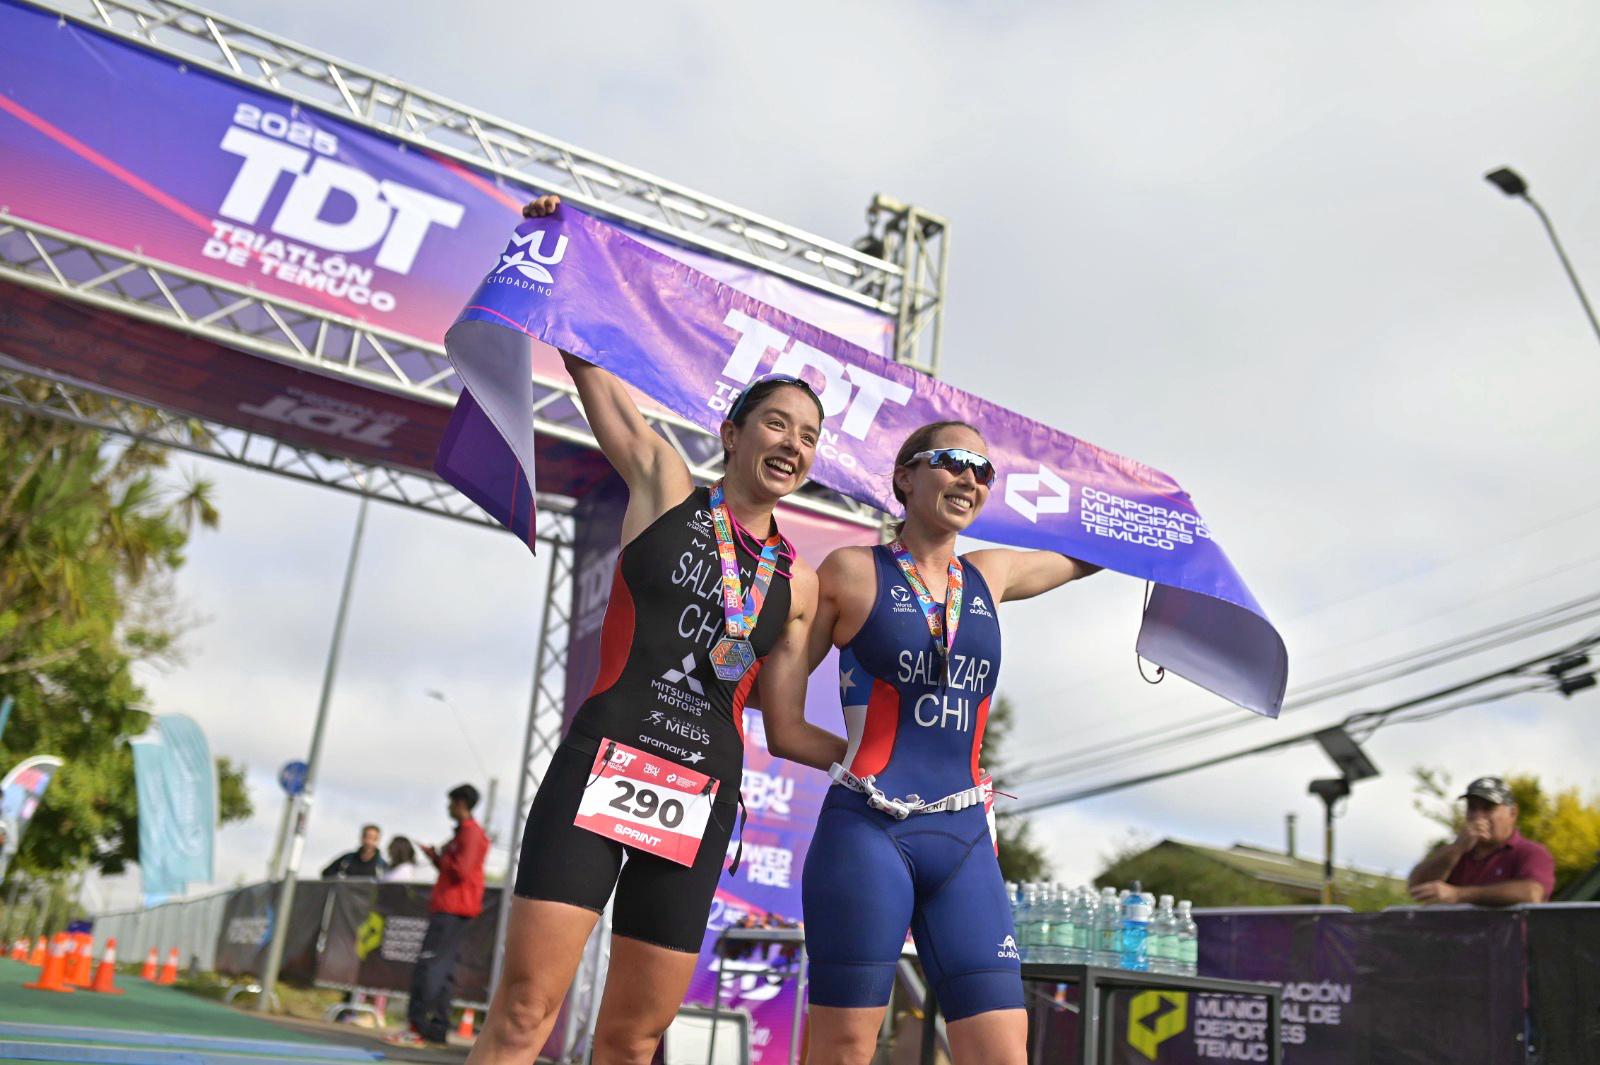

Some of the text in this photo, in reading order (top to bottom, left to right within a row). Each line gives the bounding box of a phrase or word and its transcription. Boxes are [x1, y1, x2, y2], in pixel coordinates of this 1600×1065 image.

[233, 103, 339, 157] 2025
[219, 126, 465, 275] TDT
[211, 220, 373, 286] TRIATLÓN
[511, 230, 569, 265] MU
[202, 241, 397, 313] DE TEMUCO
[487, 276, 552, 297] CIUDADANO
[721, 308, 913, 442] TDT
[1080, 498, 1216, 541] MUNICIPAL D
[1081, 486, 1212, 532] CORPORACI
[1080, 510, 1194, 545] DEPORTES
[1081, 522, 1175, 551] TEMUCO
[678, 603, 725, 649] CH
[651, 679, 711, 711] MITSUBISHI
[657, 692, 702, 717] MOTORS
[914, 693, 969, 732] CHI
[639, 735, 689, 758] aramark
[665, 719, 710, 745] MEDS
[605, 744, 638, 768] DT
[608, 780, 685, 829] 290
[613, 823, 662, 847] SPRINT
[1195, 999, 1341, 1024] MUNICIAL DE
[1195, 1019, 1306, 1044] DEPORES
[1195, 1038, 1284, 1062] TEMUC
